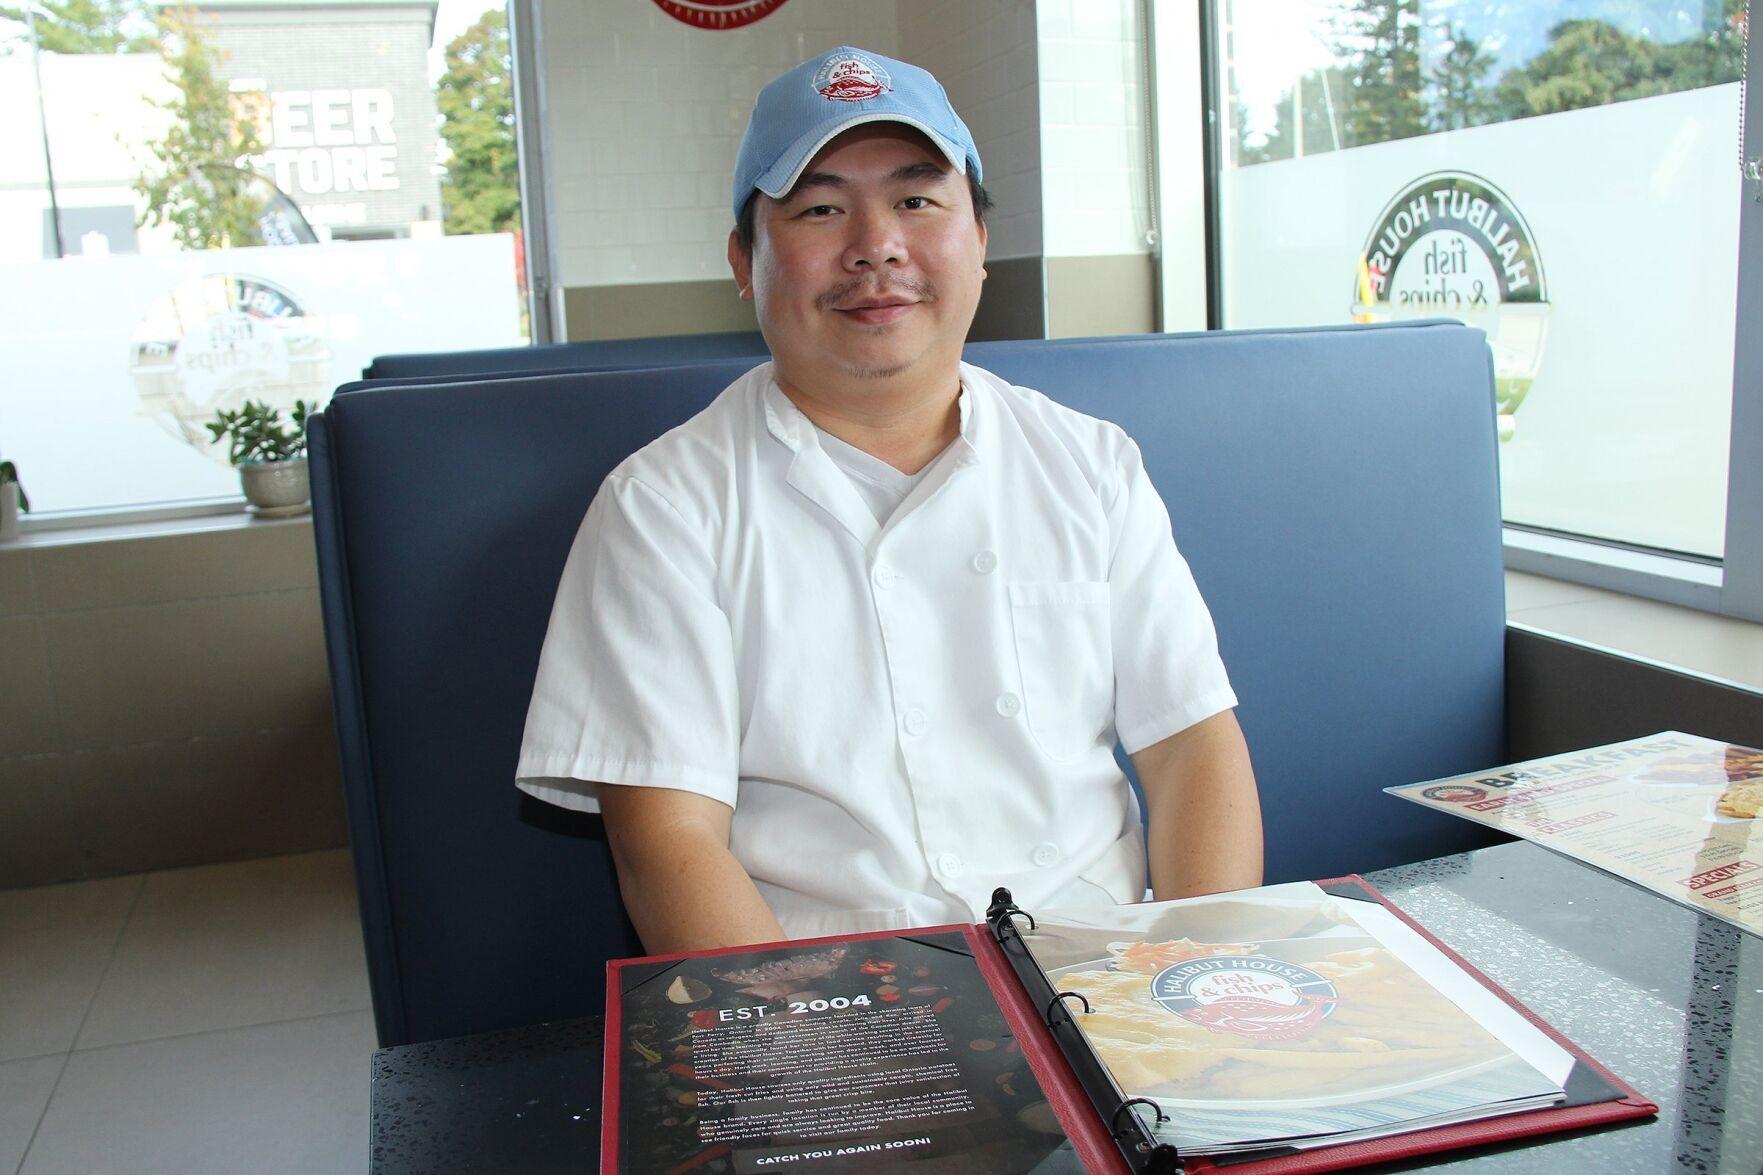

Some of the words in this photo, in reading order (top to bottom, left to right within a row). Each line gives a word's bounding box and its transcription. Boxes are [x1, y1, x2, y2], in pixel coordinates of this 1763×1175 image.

[843, 68, 871, 76] chips
[1688, 861, 1756, 889] SPECIALS
[1163, 960, 1224, 994] HALIBUT
[1232, 959, 1310, 982] HOUSE
[1200, 987, 1219, 996] &
[1222, 981, 1284, 996] chips
[1212, 973, 1254, 986] fish
[719, 1006, 776, 1022] EST.
[788, 994, 872, 1014] 2004
[756, 1153, 800, 1166] CATCH
[802, 1150, 834, 1161] YOU
[836, 1144, 882, 1157] AGAIN
[884, 1136, 932, 1151] SOON!
